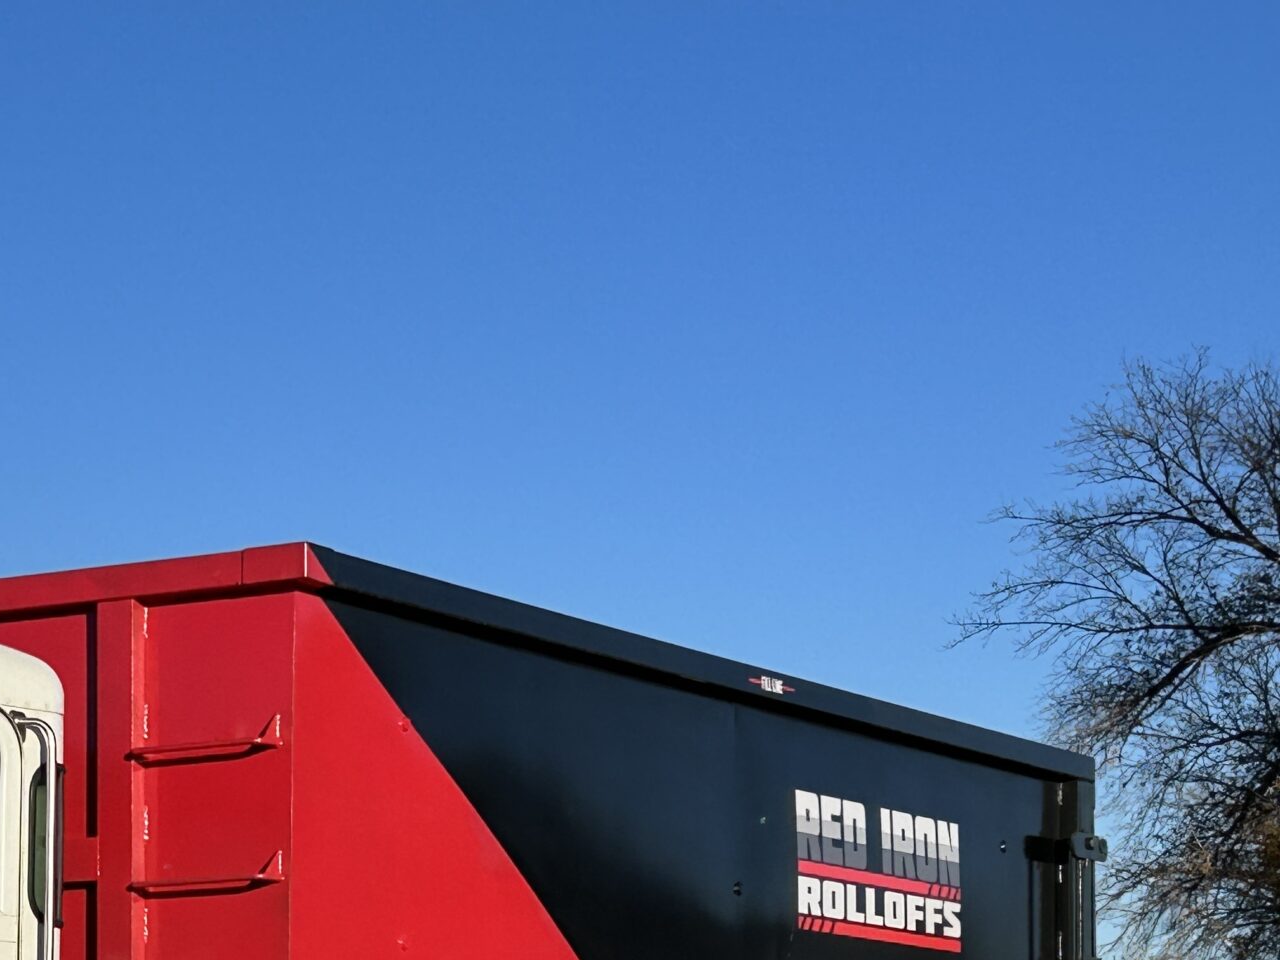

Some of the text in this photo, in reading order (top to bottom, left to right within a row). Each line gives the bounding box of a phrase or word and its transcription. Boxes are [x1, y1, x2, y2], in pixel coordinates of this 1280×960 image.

[795, 789, 961, 887] RED IRON
[797, 875, 962, 938] ROLLOFFS
